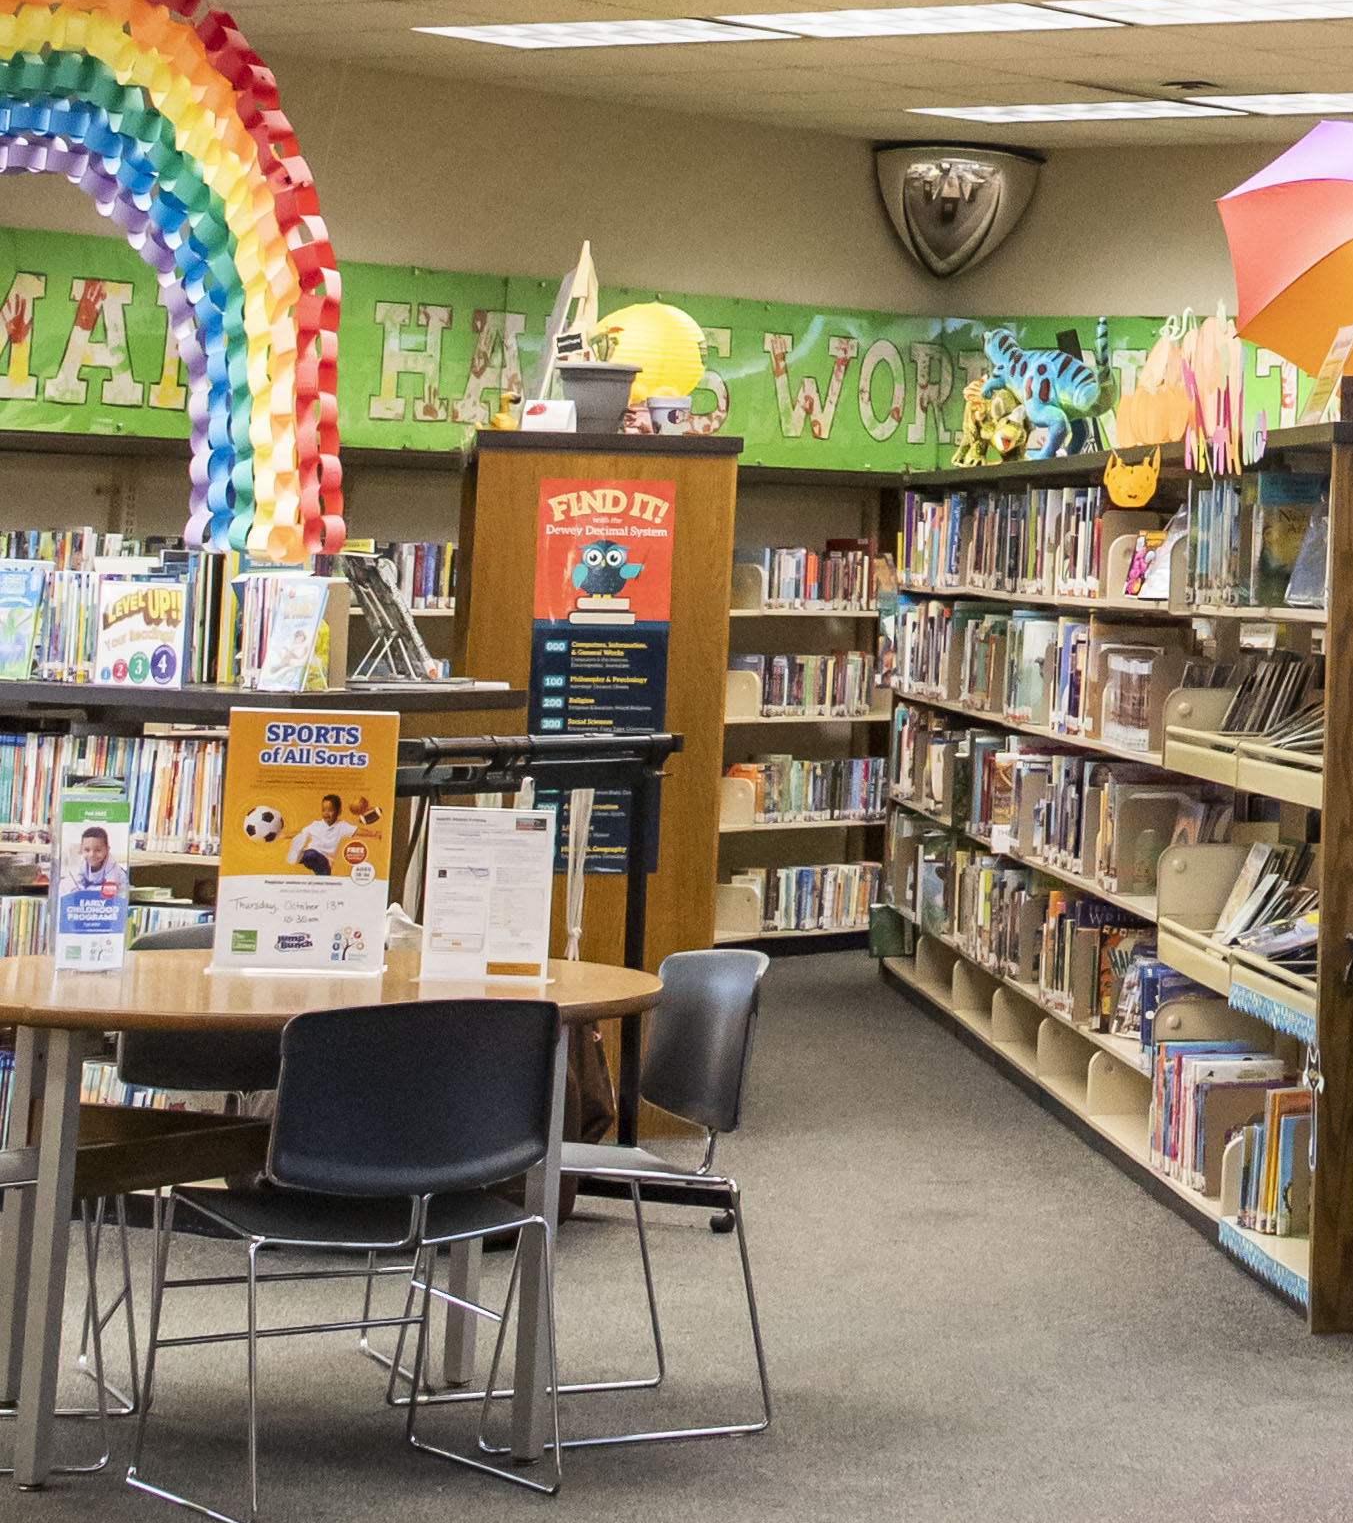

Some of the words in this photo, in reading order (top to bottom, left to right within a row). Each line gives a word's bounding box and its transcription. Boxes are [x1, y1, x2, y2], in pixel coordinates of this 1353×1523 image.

[547, 489, 628, 522] FIND
[629, 492, 670, 524] IT!
[545, 524, 583, 536] Dewey
[585, 525, 628, 536] Decimal
[630, 526, 668, 538] System
[103, 589, 145, 631] LEVEL
[143, 588, 183, 628] UP!!
[117, 665, 123, 677] 2
[135, 659, 142, 675] 3
[158, 655, 168, 673] 4
[545, 677, 563, 686] 100
[266, 723, 361, 746] SPORTS
[259, 747, 282, 764] of
[283, 747, 311, 764] All
[314, 750, 368, 767] Sorts
[80, 898, 106, 907] EARLY
[284, 899, 320, 911] October
[66, 906, 119, 915] CHILDHOOD
[67, 913, 118, 922] PROGRAMS
